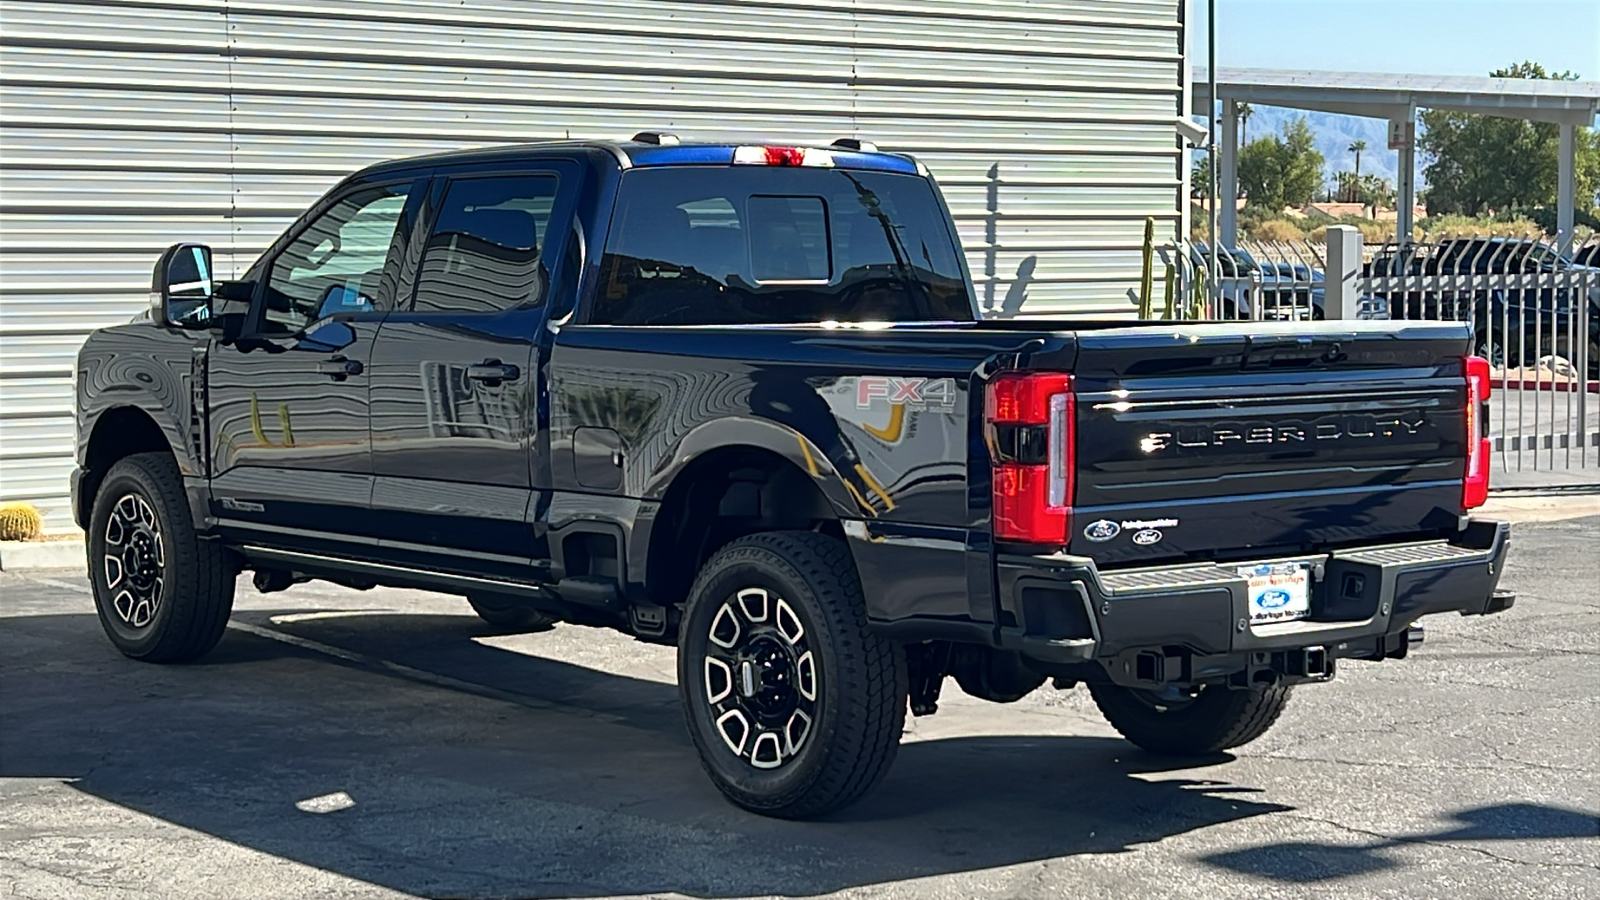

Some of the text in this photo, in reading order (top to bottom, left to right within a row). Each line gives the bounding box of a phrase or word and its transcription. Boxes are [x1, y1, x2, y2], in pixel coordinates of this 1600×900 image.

[856, 377, 956, 409] FX4
[1141, 419, 1424, 452] SUPER DUTY
